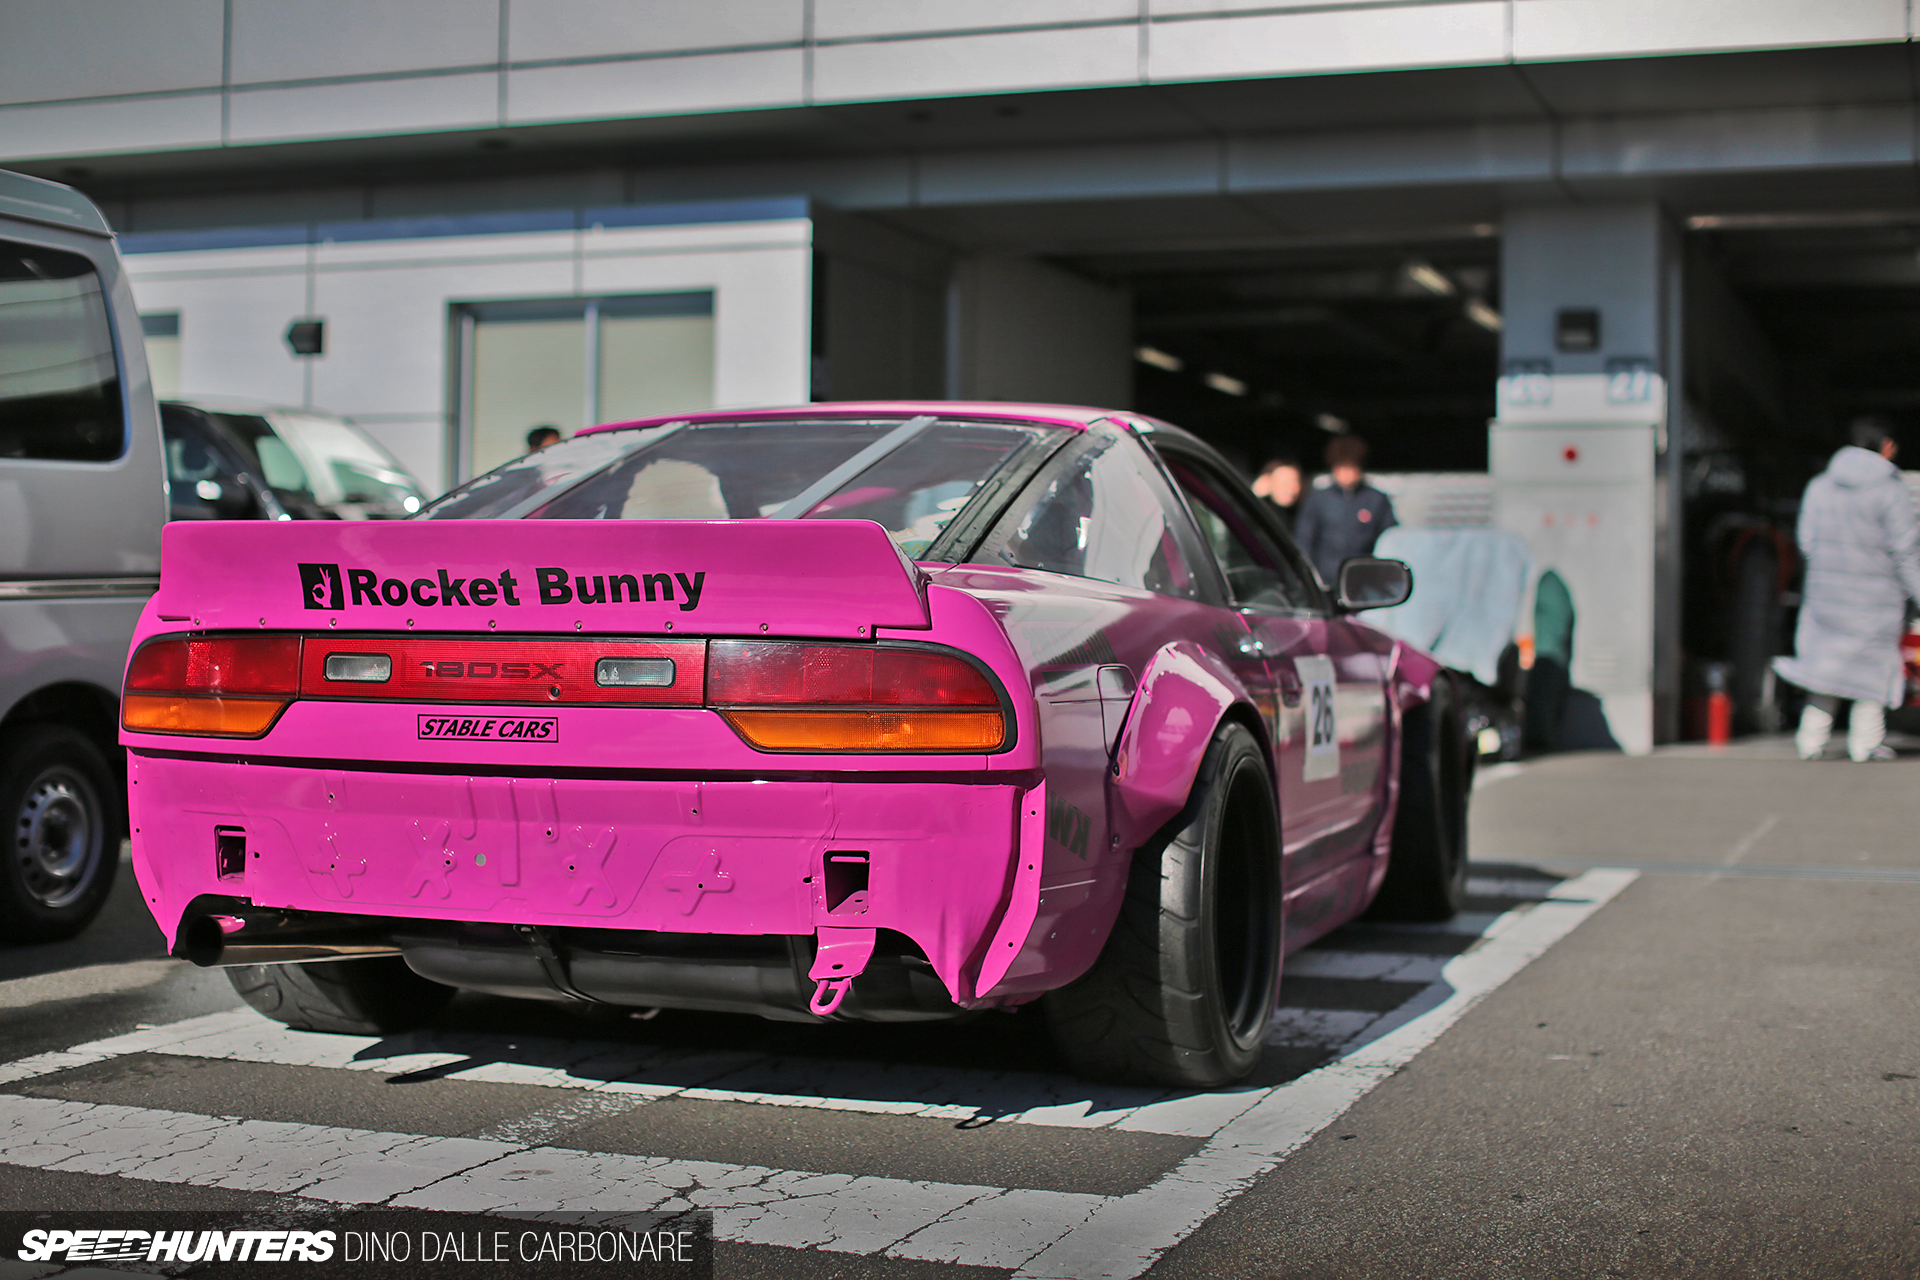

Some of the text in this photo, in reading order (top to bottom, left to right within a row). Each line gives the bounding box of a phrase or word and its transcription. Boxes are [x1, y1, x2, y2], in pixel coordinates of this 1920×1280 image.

[347, 567, 706, 611] Rocket Bunny
[419, 661, 564, 680] 180SX
[421, 719, 554, 739] STABLE CARS
[1312, 684, 1334, 745] 26
